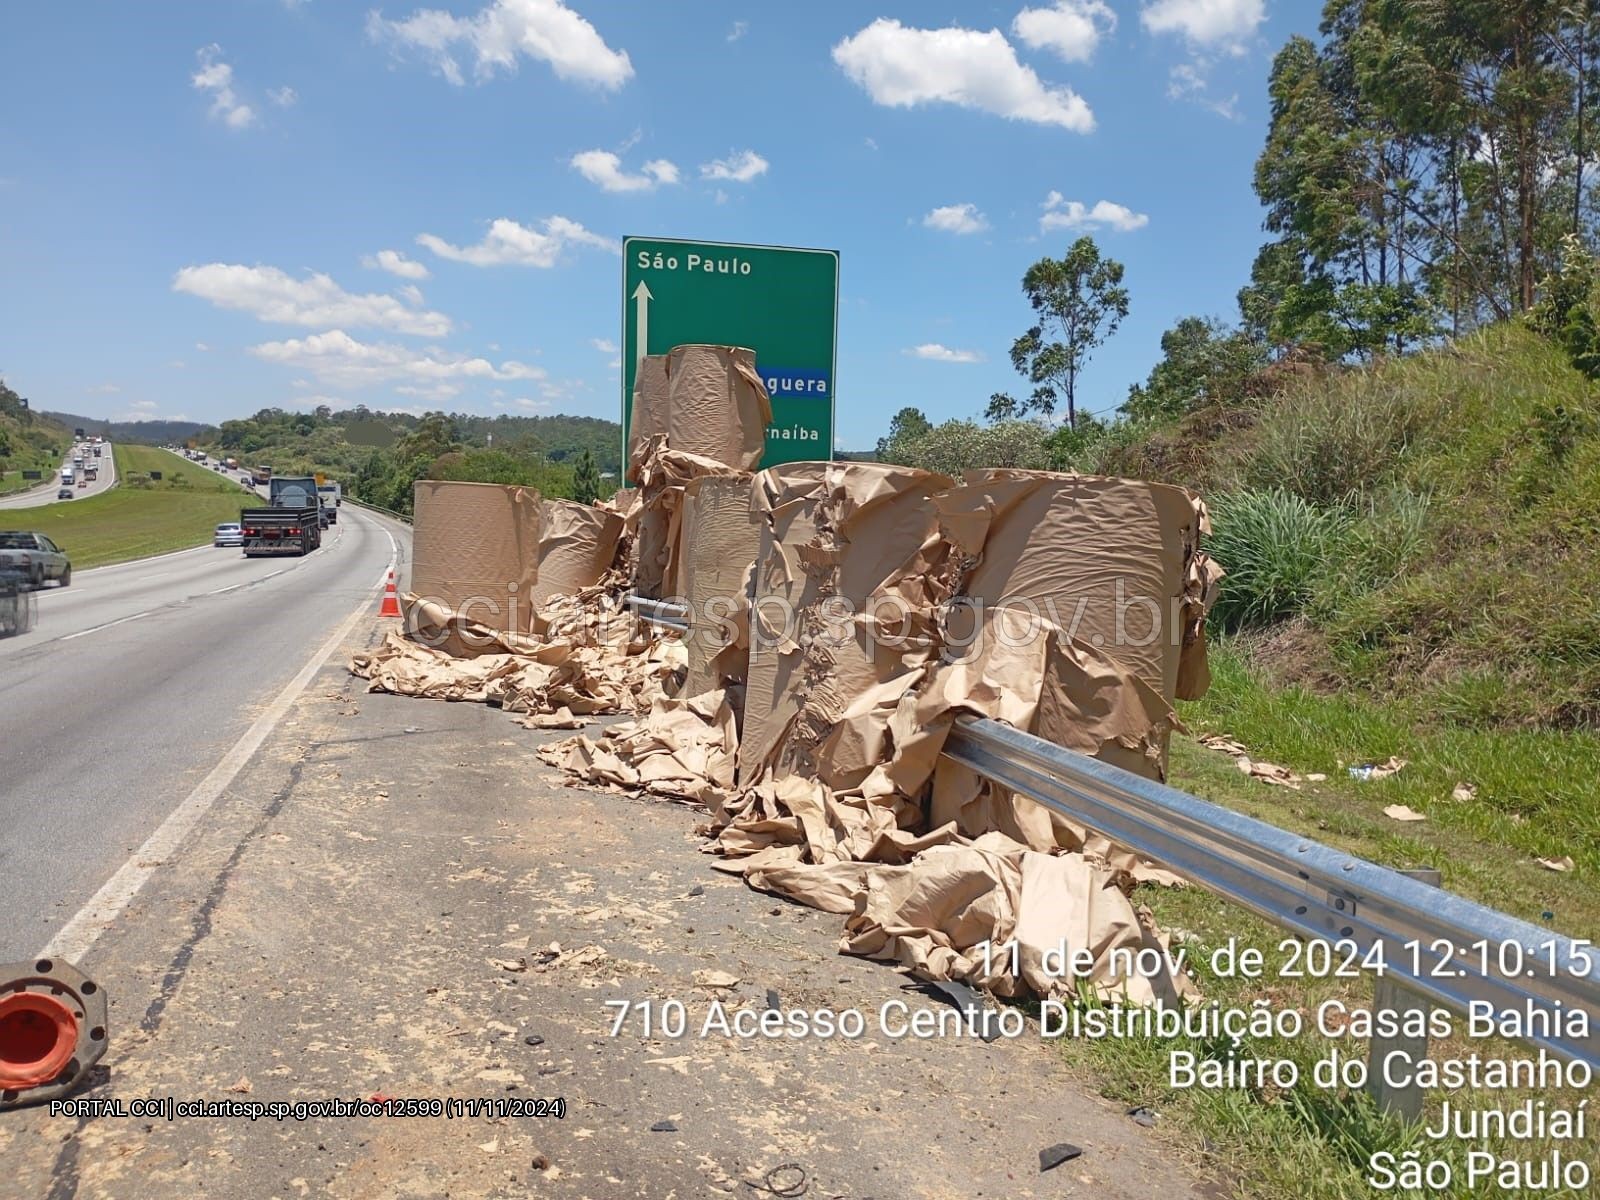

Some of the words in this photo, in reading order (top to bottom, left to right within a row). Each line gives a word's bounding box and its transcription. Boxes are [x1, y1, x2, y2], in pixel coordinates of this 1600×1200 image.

[687, 254, 751, 275] Paulo
[760, 377, 827, 395] guera
[766, 423, 819, 440] naíba
